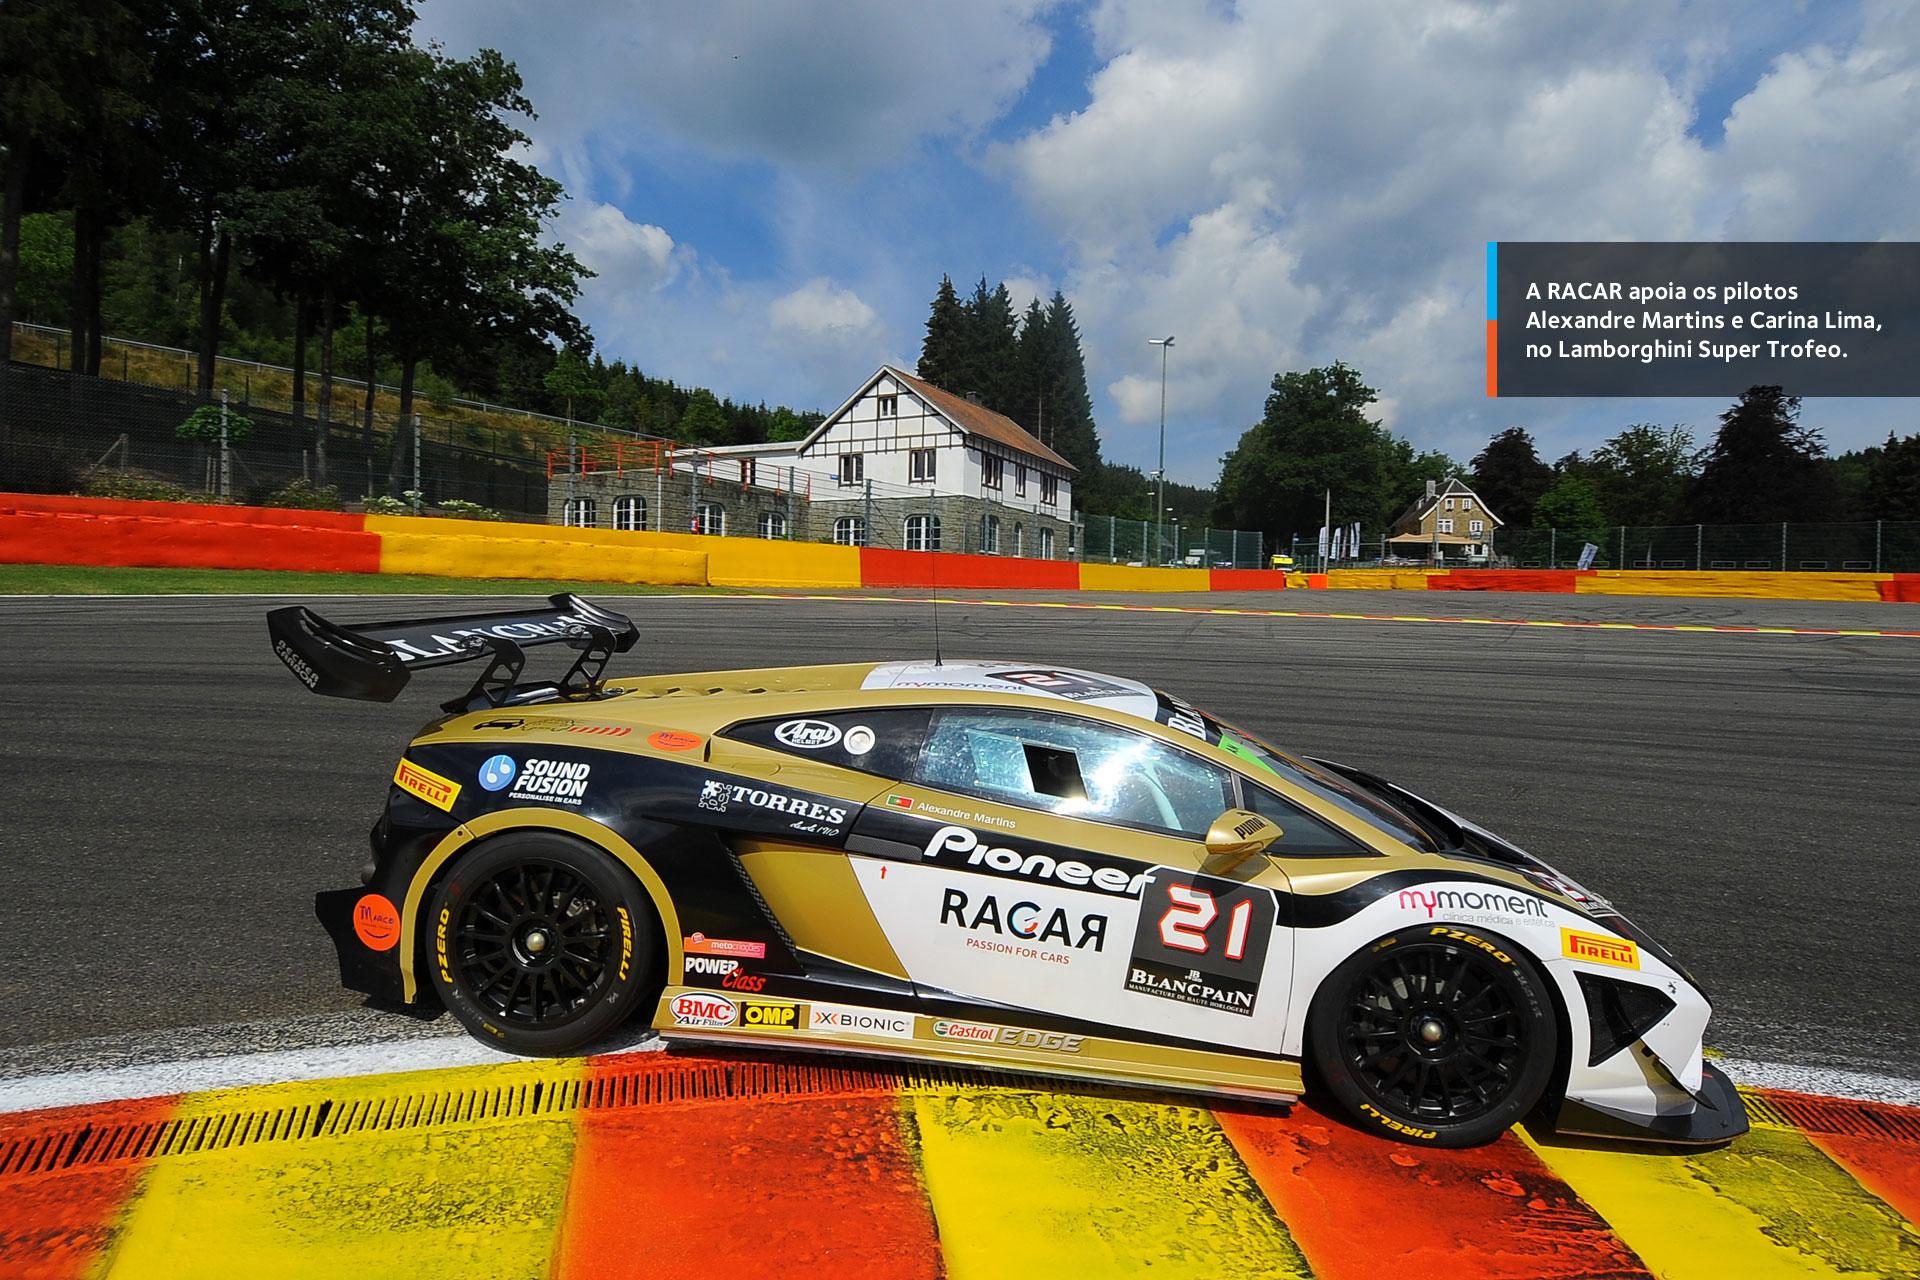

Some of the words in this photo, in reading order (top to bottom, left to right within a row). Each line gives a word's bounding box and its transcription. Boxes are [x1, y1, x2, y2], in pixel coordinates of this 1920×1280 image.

[276, 646, 317, 688] CARBON
[781, 721, 836, 741] Arai
[791, 737, 822, 746] HELMET
[521, 758, 591, 780] SOUND
[399, 764, 452, 804] PIRELLI
[513, 775, 589, 797] FUSION
[732, 785, 847, 824] TORRES
[917, 802, 971, 820] Alexandre
[974, 812, 1017, 829] Martins
[1234, 817, 1267, 840] PUMA
[923, 825, 1157, 895] Pioneer
[1399, 890, 1548, 918] mymoment
[1158, 882, 1253, 960] 21
[436, 908, 454, 983] PZERO
[617, 907, 632, 981] PIRELLI
[967, 938, 1013, 955] PASSION
[1016, 947, 1038, 959] FOR
[1040, 952, 1071, 965] CARS
[1429, 927, 1513, 964] PZERO
[1570, 934, 1633, 964] PIRELLI
[685, 956, 739, 978] POWER
[722, 967, 767, 992] Class
[1128, 983, 1176, 999] MANUFACTURE
[1130, 968, 1254, 1008] BLANCPAIN
[676, 998, 731, 1021] BMC
[677, 1015, 702, 1026] Air
[745, 1006, 796, 1025] OMP
[840, 1016, 905, 1033] BIONIC
[948, 1023, 996, 1041] Castrol
[998, 1028, 1084, 1053] EDGE
[1360, 1103, 1438, 1140] PIRELLI
